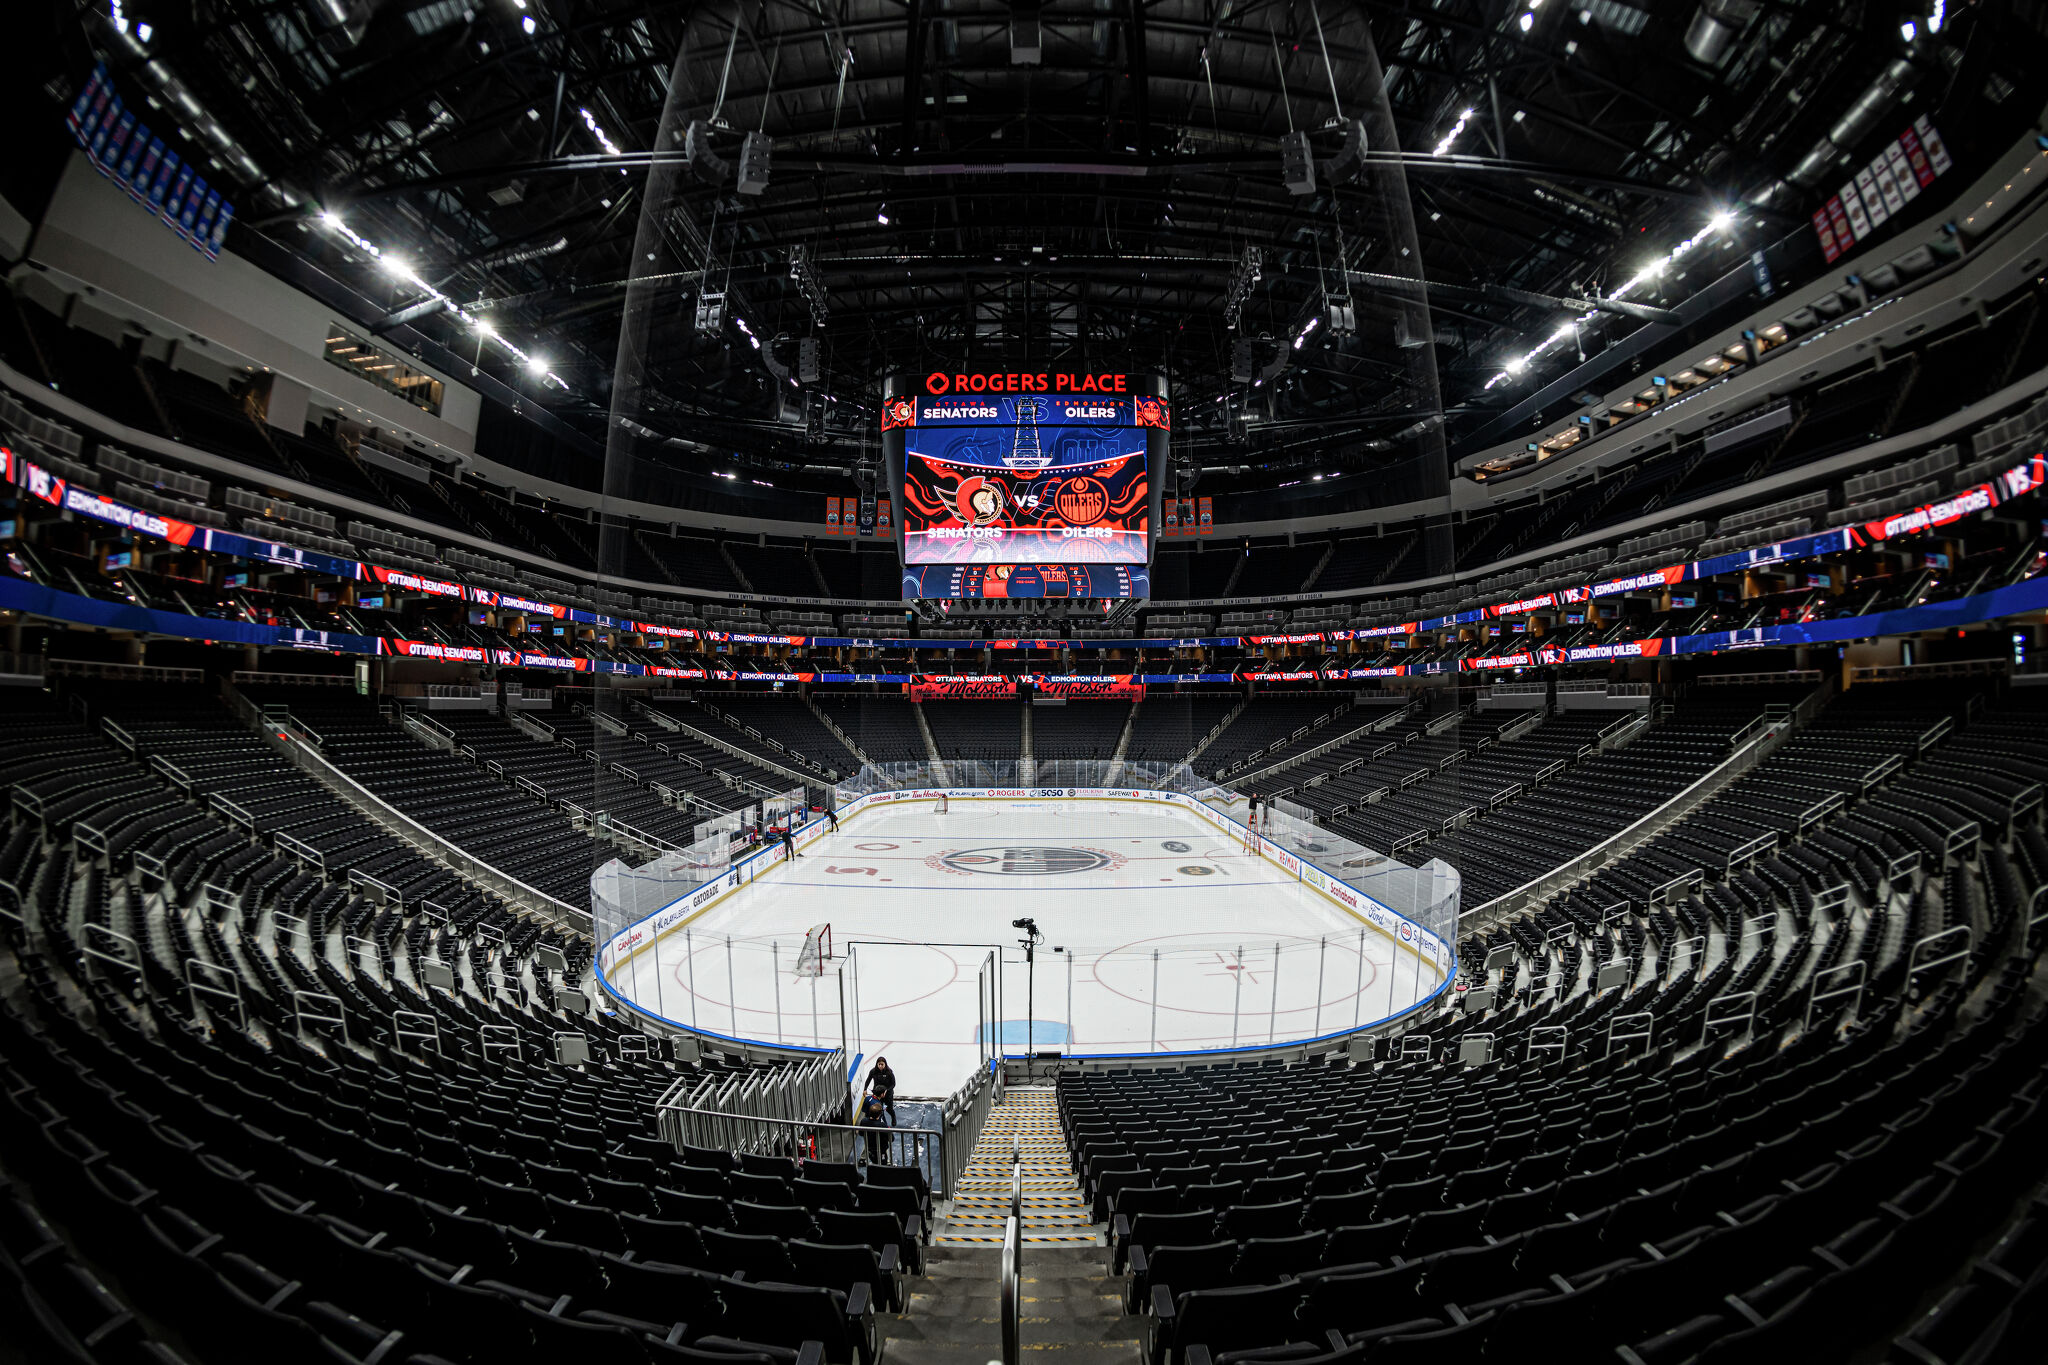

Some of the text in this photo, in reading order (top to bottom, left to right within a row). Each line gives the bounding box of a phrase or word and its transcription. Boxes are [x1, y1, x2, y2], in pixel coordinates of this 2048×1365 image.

[955, 373, 1127, 392] ROGERS PLACE
[923, 407, 998, 419] SENATORS
[1065, 407, 1116, 418] OILERS
[28, 465, 50, 497] VS
[2005, 465, 2030, 498] VS
[1014, 495, 1039, 507] VS
[1060, 492, 1102, 522] OILERS
[66, 489, 169, 537] EDMONTON OILERS
[1885, 489, 1990, 537] OTTAWA SENATORS
[927, 527, 1003, 538] SENATORS
[1062, 527, 1113, 538] OILERS
[387, 572, 555, 615] OTTAWA SENATORS VS EDMONTON OILERS
[1499, 572, 1666, 615] OTTAWA SENATORS VS EDMONTON OILERS
[646, 626, 791, 644] OTTAWA SENATORS VS EDMONTON OILERS
[1260, 625, 1406, 644] OTTAWA SENATORS VS EDMONTON OILERS
[409, 643, 576, 668] OTTAWA SENATORS VS EDMONTON OILERS
[1475, 643, 1642, 668] OTTAWA SENATORS VS EDMONTON OILERS
[656, 669, 800, 681] OTTAWA SENATORS VS EDMONTON OILERS
[935, 675, 965, 683] OTTAWA
[965, 675, 1003, 683] SENATORS
[1020, 675, 1034, 683] VS
[1254, 668, 1397, 681] OTTAWA SENATORS VS EDMONTON OILERS
[940, 682, 1009, 695] Molson
[869, 794, 891, 803] Scotiabank
[911, 790, 923, 799] Tim
[996, 789, 1026, 797] ROGERS
[1279, 850, 1299, 873] RE/MAX
[692, 884, 719, 908] GATORADE
[1330, 881, 1358, 909] Scotiabank
[663, 905, 690, 927] PLAYALBERTA
[1368, 903, 1385, 926] Ford
[1402, 925, 1411, 937] Esso
[1413, 929, 1437, 955] Supreme
